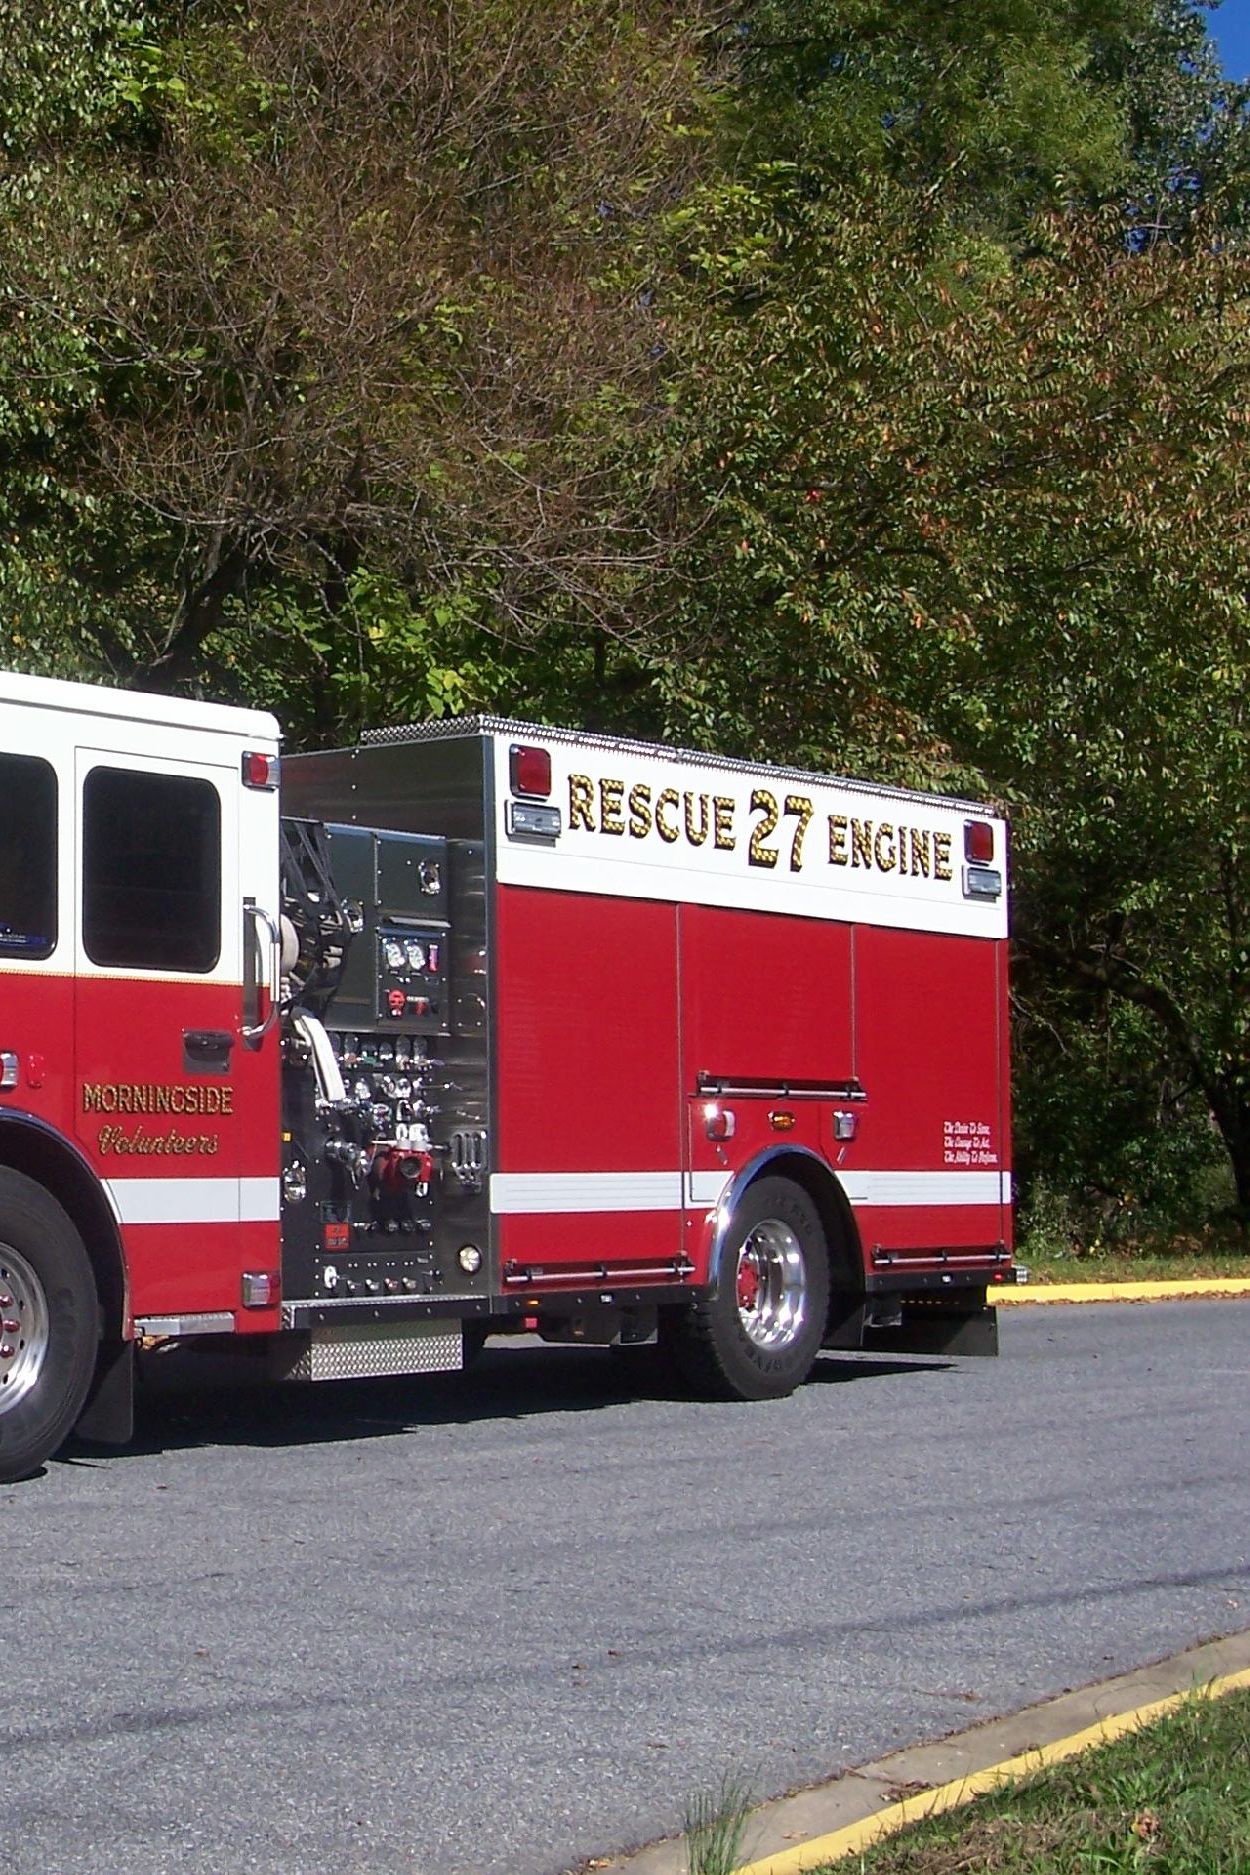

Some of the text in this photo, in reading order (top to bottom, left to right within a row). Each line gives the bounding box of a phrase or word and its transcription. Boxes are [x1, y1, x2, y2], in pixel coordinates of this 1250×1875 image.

[567, 773, 953, 882] RESCUE 27 ENGINE
[83, 1082, 234, 1115] MORNINGSIDE
[98, 1124, 219, 1156] Volunteers
